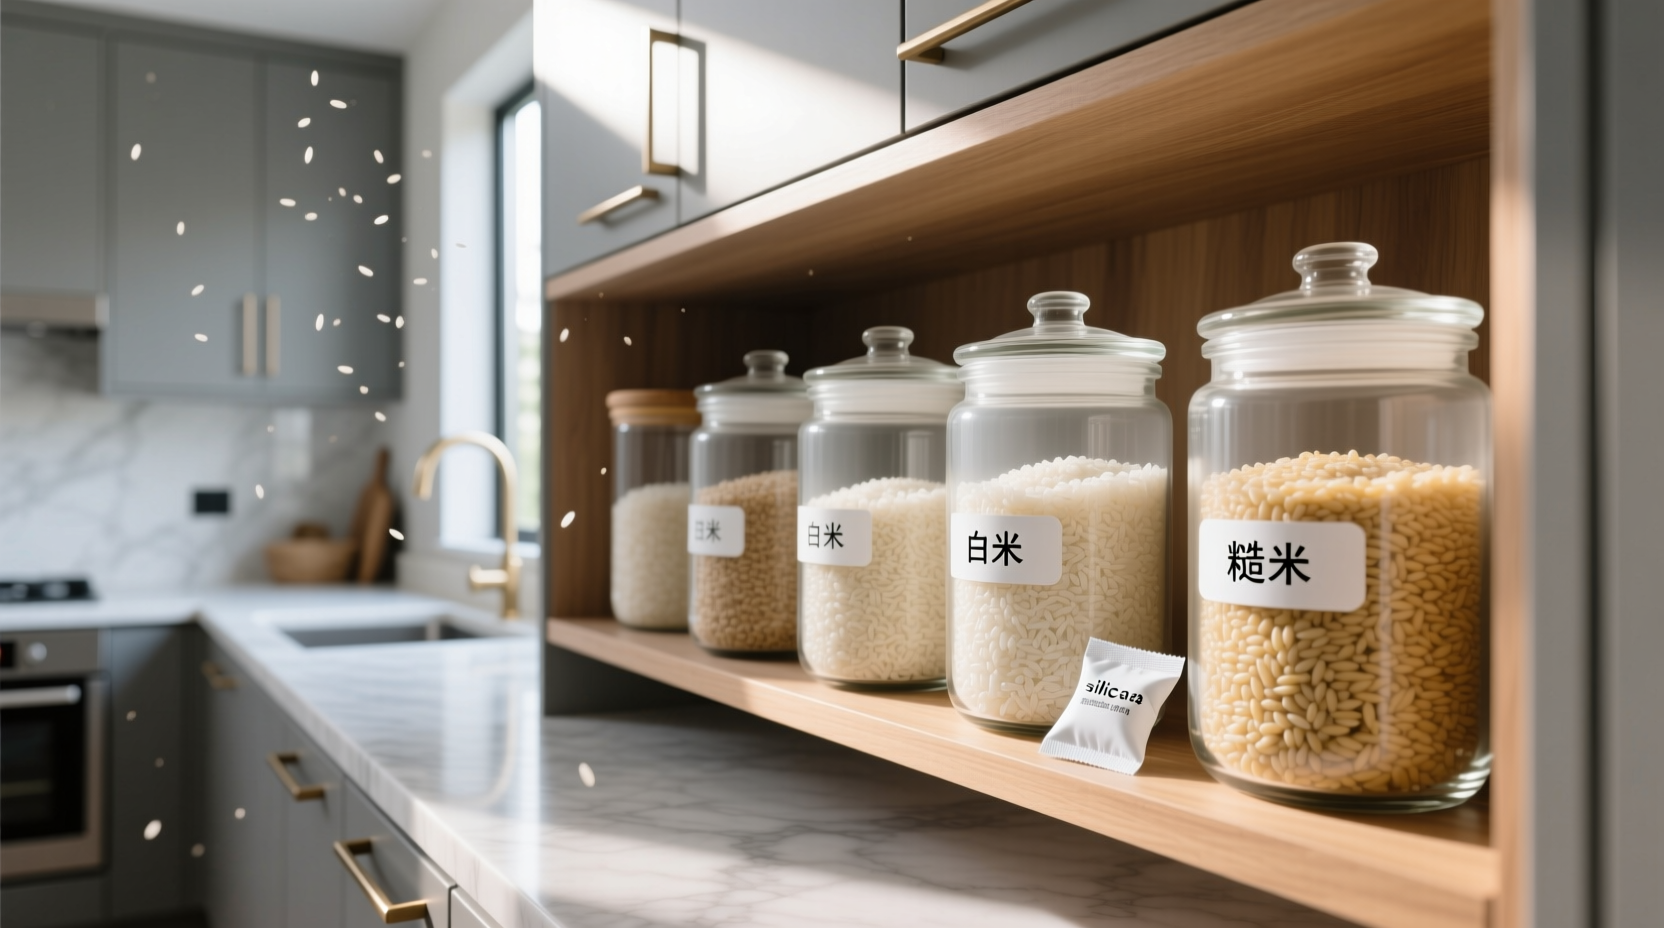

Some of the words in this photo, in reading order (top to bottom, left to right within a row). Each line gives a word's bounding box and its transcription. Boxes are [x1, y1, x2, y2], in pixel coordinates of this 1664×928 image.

[808, 522, 844, 549] 白米
[968, 530, 1023, 566] 白米
[1227, 540, 1311, 585] 糙米
